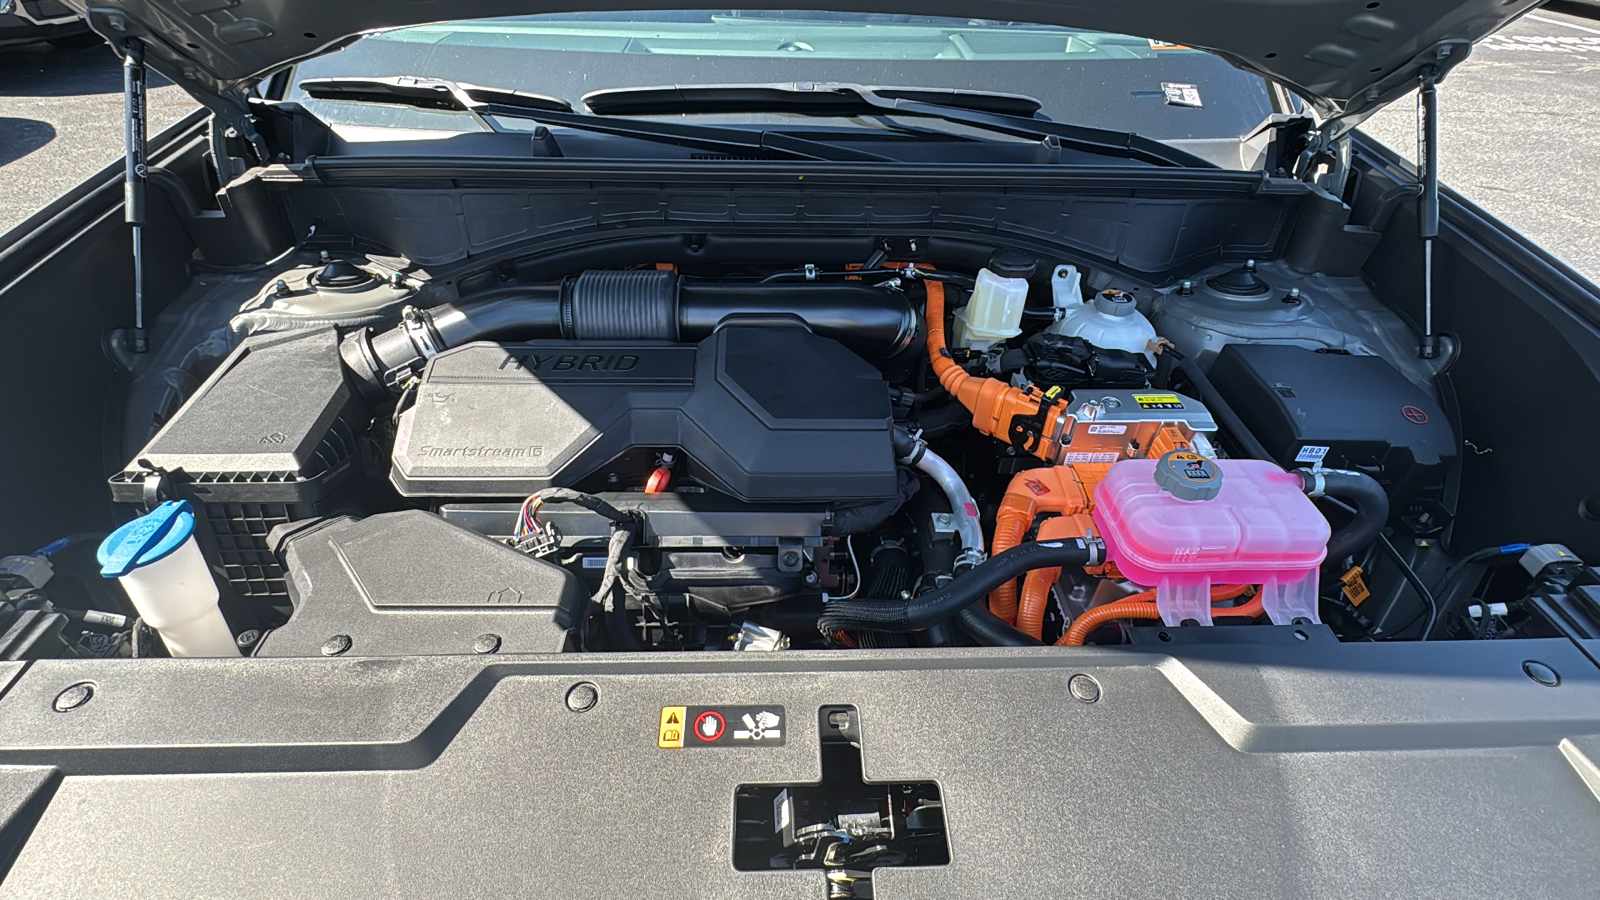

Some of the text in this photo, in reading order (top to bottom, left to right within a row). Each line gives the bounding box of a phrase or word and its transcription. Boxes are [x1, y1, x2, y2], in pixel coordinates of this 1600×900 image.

[498, 354, 640, 372] HYBRID
[417, 445, 526, 457] Smartstream
[1301, 447, 1328, 455] HB01
